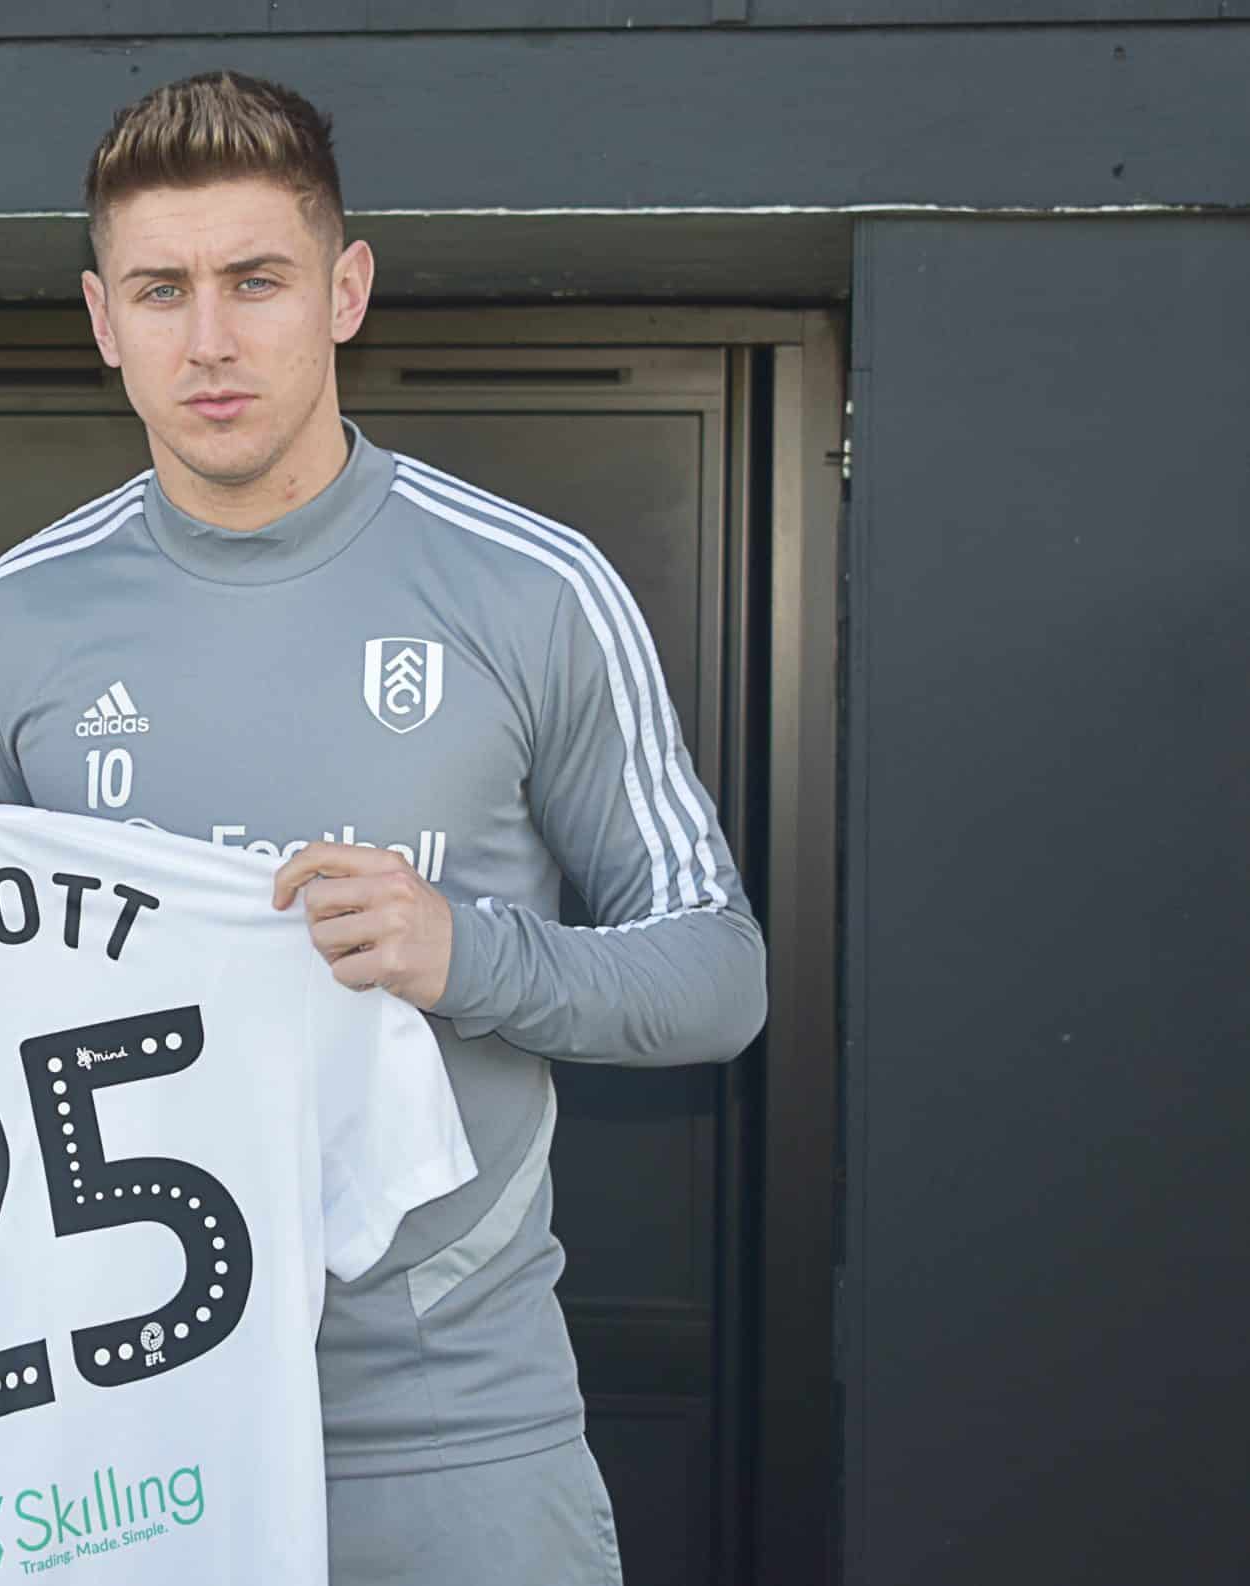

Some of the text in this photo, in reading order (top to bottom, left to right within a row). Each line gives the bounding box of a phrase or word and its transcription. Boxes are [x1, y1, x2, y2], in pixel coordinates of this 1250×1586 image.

[75, 715, 150, 736] adidas
[86, 748, 133, 808] 10
[212, 825, 446, 882] Fall
[145, 1351, 166, 1367] EFL
[15, 1464, 204, 1551] Skilling
[20, 1521, 169, 1575] Trading. Made. Simple.
